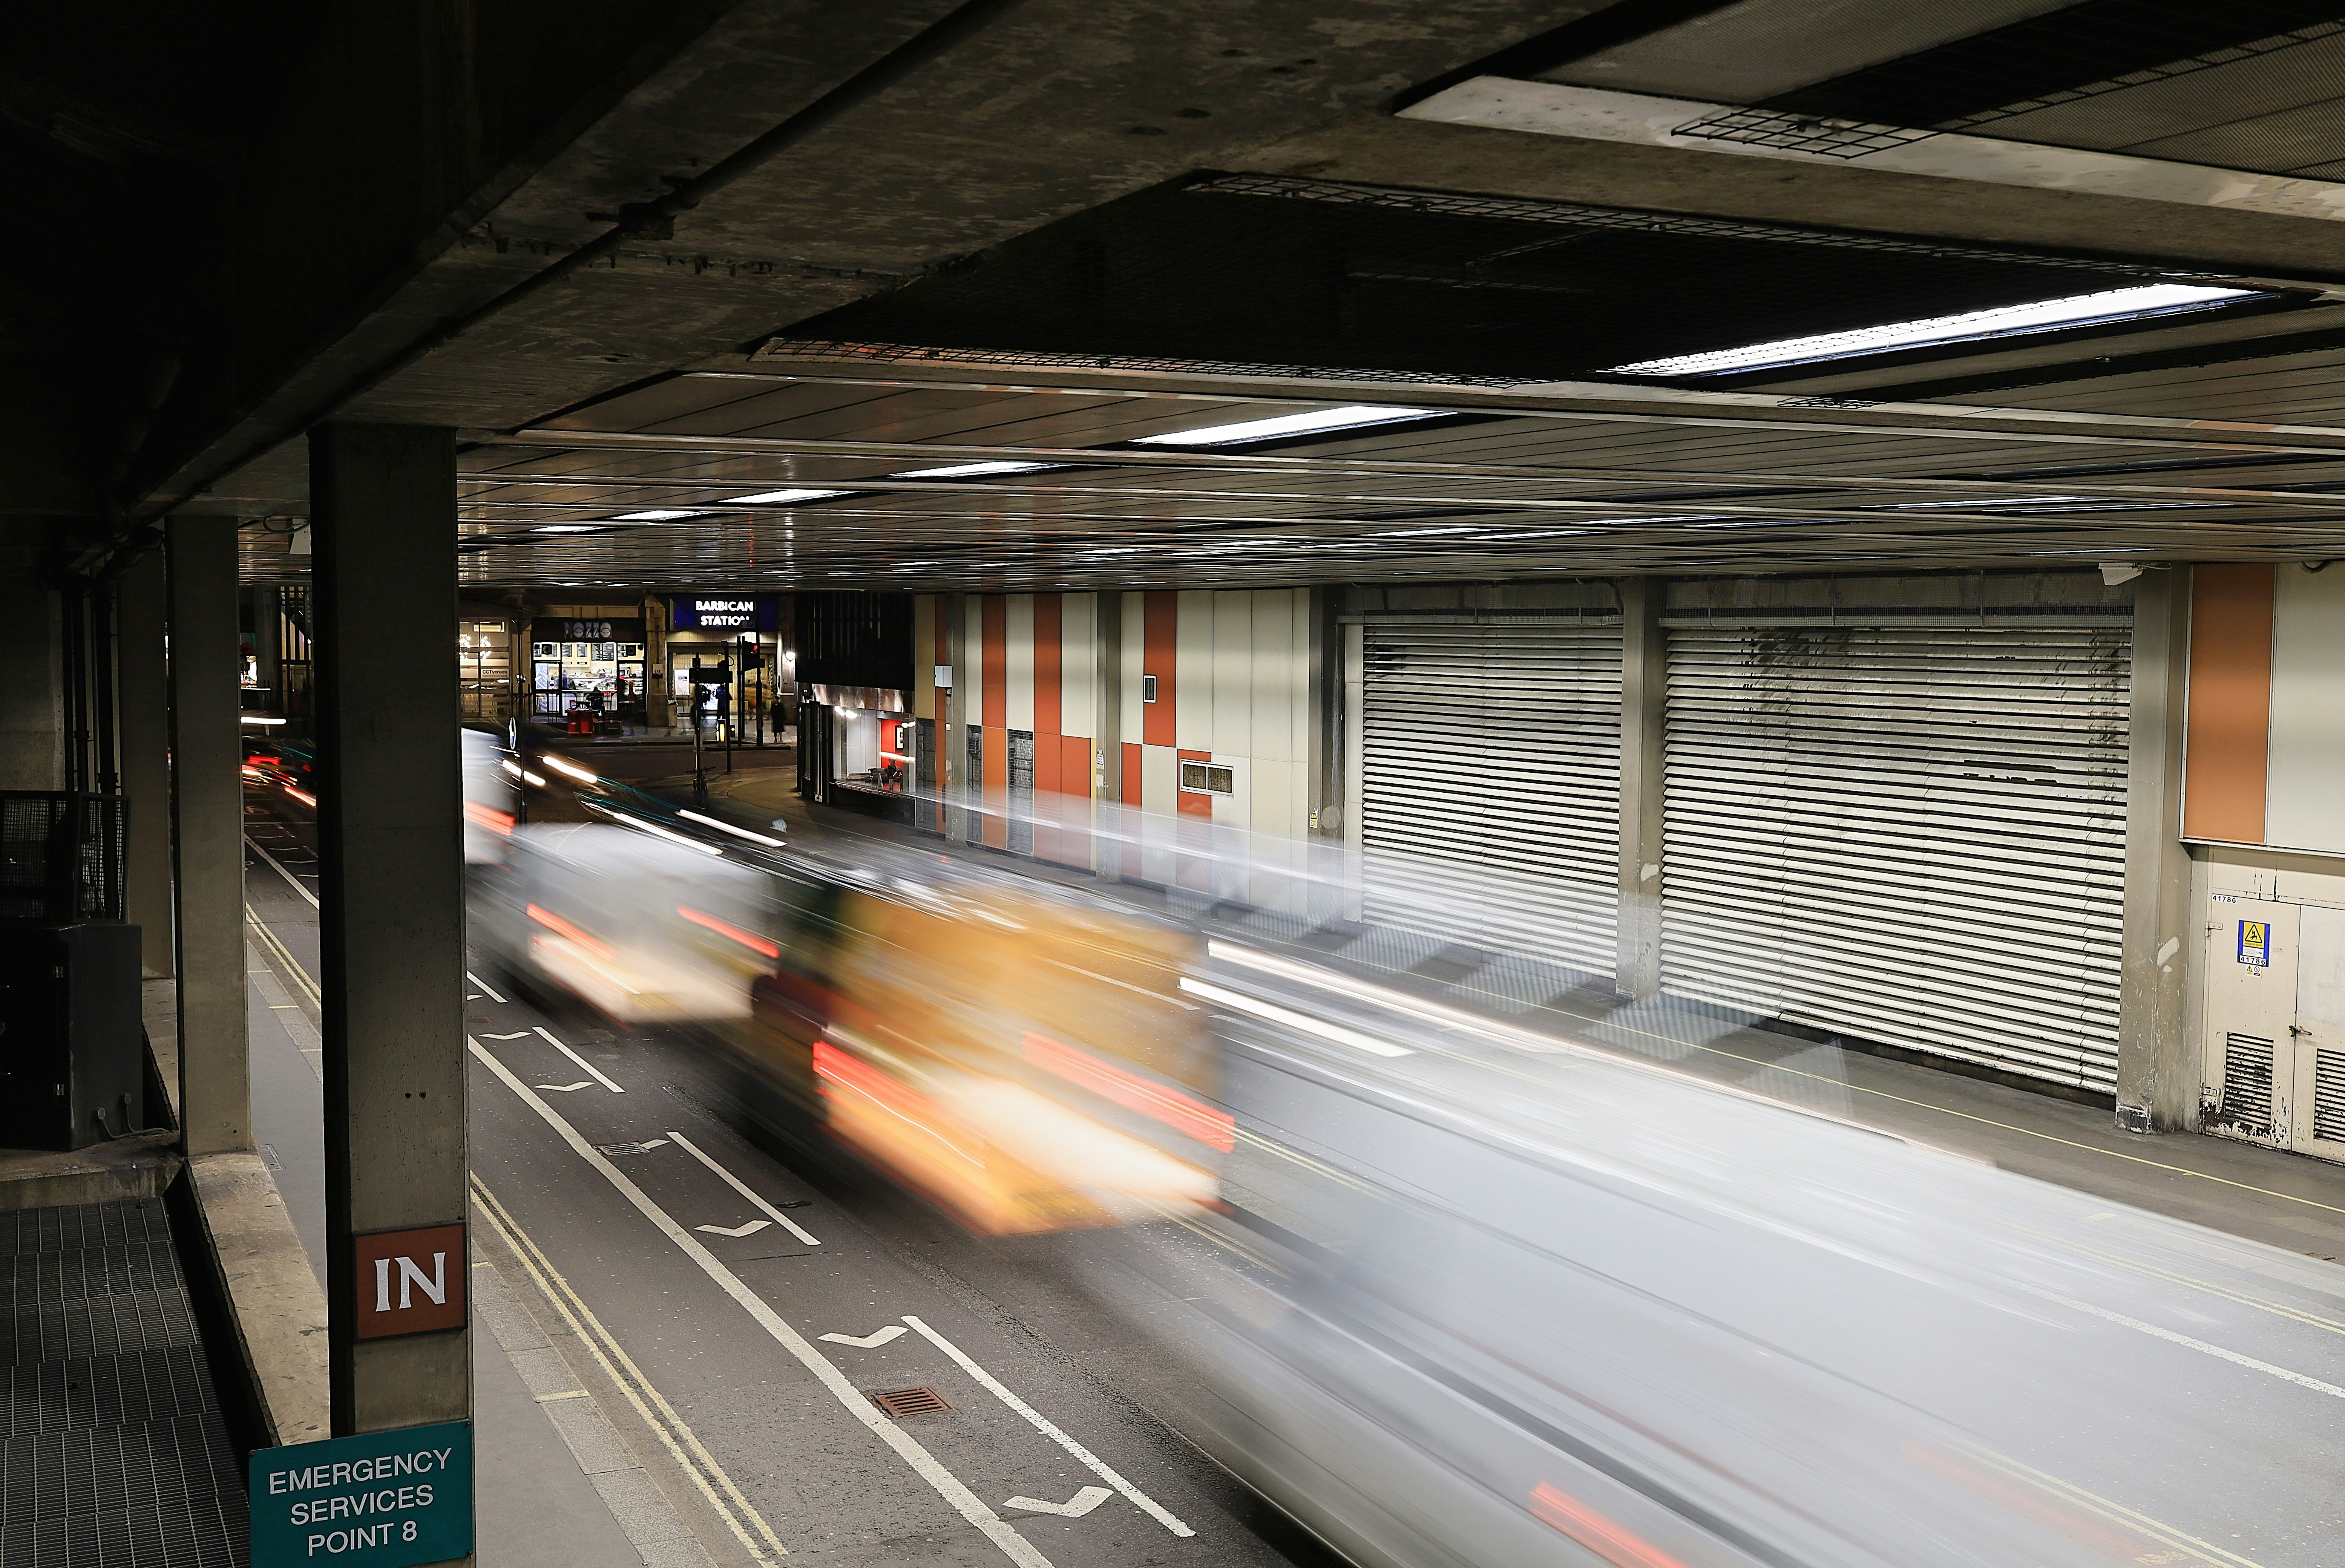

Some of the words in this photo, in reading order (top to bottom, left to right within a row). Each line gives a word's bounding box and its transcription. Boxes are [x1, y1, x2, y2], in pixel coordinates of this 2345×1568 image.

[696, 601, 753, 611] BARBICAN
[2241, 956, 2265, 965] 41786
[374, 1252, 446, 1312] IN
[269, 1447, 452, 1495] EMERGENCY
[291, 1484, 434, 1525] SERVICES
[308, 1523, 394, 1557] POINT
[402, 1521, 417, 1542] 8
